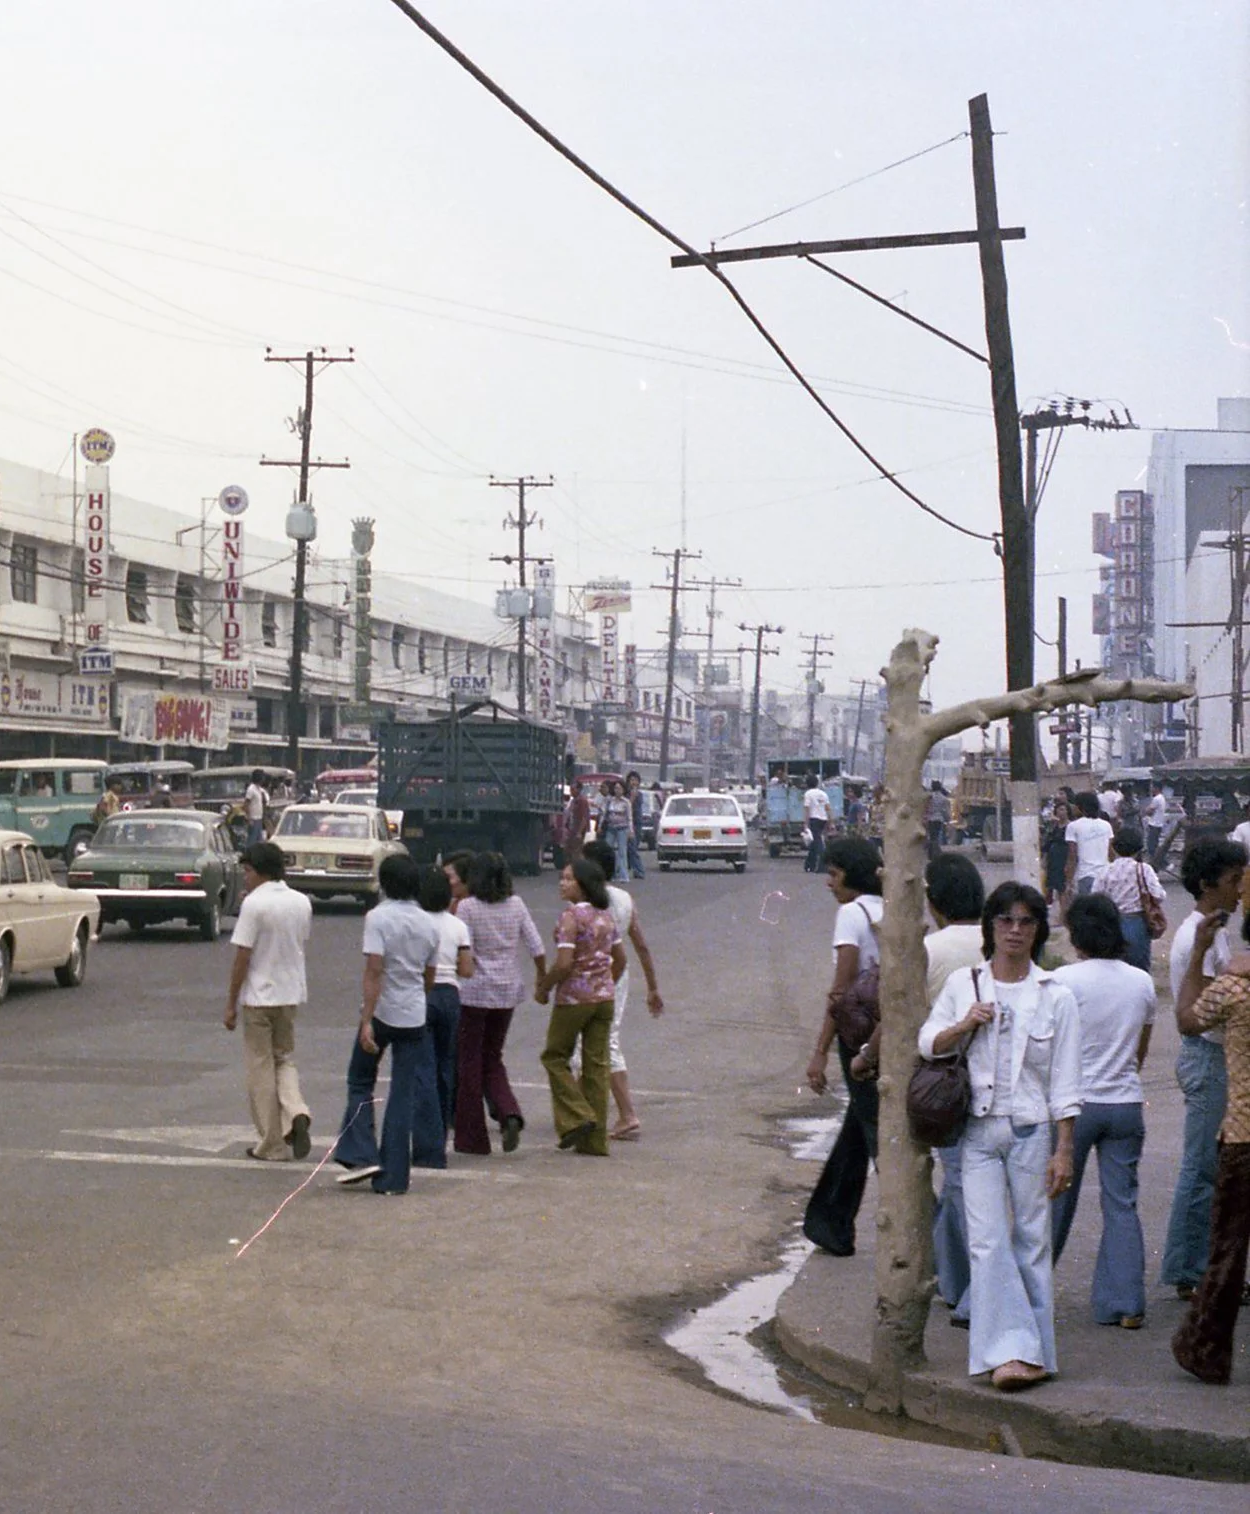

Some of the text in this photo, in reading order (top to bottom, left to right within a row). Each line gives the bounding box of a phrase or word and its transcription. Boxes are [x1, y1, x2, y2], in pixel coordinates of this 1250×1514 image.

[81, 493, 111, 670] HOUSE OF ITM
[223, 521, 240, 662] UNIWIDE
[215, 668, 249, 690] SALES
[450, 676, 487, 690] GEM
[603, 616, 616, 700] DELTA
